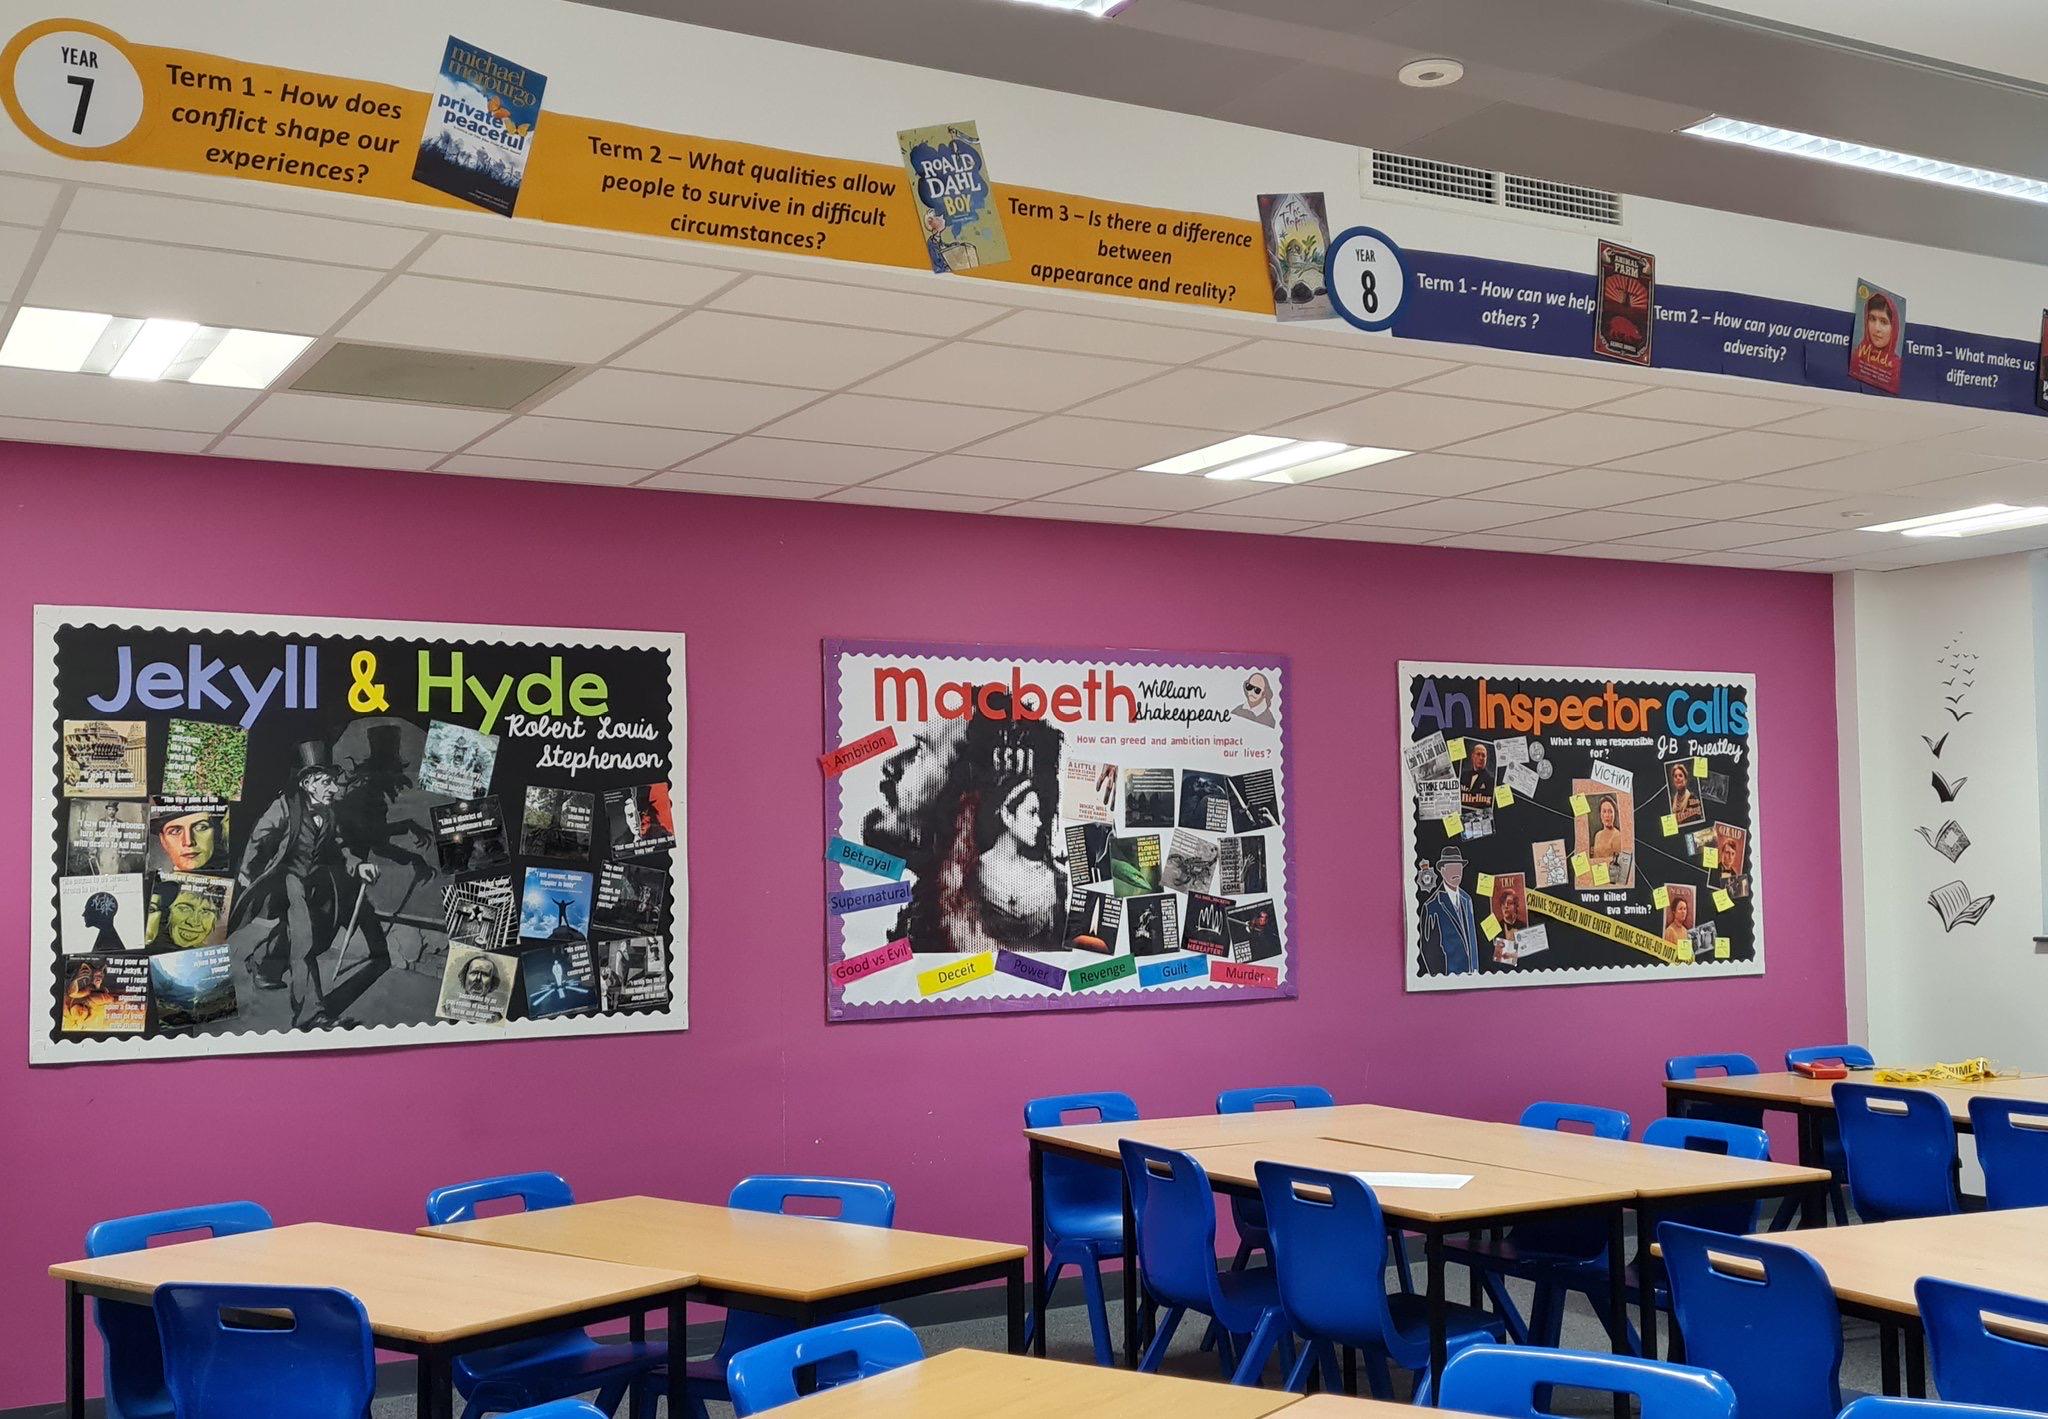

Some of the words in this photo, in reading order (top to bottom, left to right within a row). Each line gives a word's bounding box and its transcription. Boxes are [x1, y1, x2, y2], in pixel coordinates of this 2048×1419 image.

[61, 46, 98, 69] YEAR
[451, 47, 526, 87] michael
[66, 75, 95, 135] 7
[166, 63, 232, 94] Term
[242, 75, 255, 97] 1
[280, 83, 338, 110] How
[345, 93, 402, 120] does
[438, 94, 504, 128] private
[171, 104, 266, 135] conflict
[275, 117, 350, 152] shape
[357, 131, 400, 154] our
[444, 110, 525, 151] peaceful
[205, 145, 370, 185] experiences?
[588, 135, 643, 162] Term
[649, 146, 662, 164] 2
[688, 151, 745, 176] What
[750, 163, 837, 193] qualities
[843, 173, 896, 197] allow
[921, 153, 975, 179] ROALD
[926, 172, 981, 199] DAHL
[602, 171, 675, 201] people
[681, 182, 701, 201] to
[707, 188, 780, 214] survive
[787, 197, 805, 216] in
[811, 201, 887, 228] difficult
[943, 194, 971, 216] BOY
[669, 214, 827, 250] circumstances?
[1008, 197, 1054, 221] Term
[1059, 205, 1069, 222] 3
[1088, 210, 1101, 228] Is
[1107, 213, 1151, 236] there
[1156, 221, 1167, 236] a
[1172, 220, 1253, 249] difference
[1097, 239, 1172, 266] between
[1355, 248, 1376, 263] YEAR
[1030, 262, 1133, 291] appearance
[1138, 275, 1170, 295] and
[1174, 278, 1237, 304] reality?
[1614, 262, 1639, 279] FARM
[1361, 270, 1378, 314] 8
[1416, 272, 1454, 293] Term
[1458, 279, 1467, 294] 1
[1480, 280, 1512, 298] How
[1517, 288, 1542, 304] can
[1546, 292, 1566, 306] we
[1568, 293, 1596, 315] help
[1482, 308, 1527, 329] others
[1531, 313, 1540, 330] ?
[1654, 305, 1687, 323] Term
[1691, 309, 1699, 325] 2
[1713, 311, 1741, 330] How
[1744, 320, 1767, 334] can
[1768, 322, 1791, 340] you
[1794, 326, 1850, 347] overcome
[1723, 339, 1787, 362] adversity?
[1906, 340, 1932, 358] Term
[1936, 344, 1943, 358] 3
[1954, 346, 1984, 366] What
[1986, 352, 2021, 371] makes
[2023, 359, 2036, 372] us
[1946, 366, 1999, 388] different?
[87, 644, 317, 729] Jekyll
[348, 650, 389, 712] &
[418, 650, 609, 735] Hyde
[1139, 680, 1206, 700] William
[1134, 701, 1233, 729] Shakespeare
[1412, 679, 1473, 728] An
[1479, 679, 1662, 735] Inspector
[1666, 687, 1749, 736] Calls
[505, 713, 586, 739] Robert
[598, 715, 660, 740] Louis
[834, 736, 887, 768] Ambition
[1077, 734, 1096, 746] How
[1100, 736, 1116, 746] can
[1119, 735, 1146, 749] greed
[1151, 735, 1167, 746] and
[1171, 735, 1209, 747] ambition
[1213, 735, 1244, 749] impact
[1223, 749, 1239, 759] our
[1243, 747, 1272, 760] lives?
[1550, 736, 1572, 747] What
[1576, 738, 1592, 747] are
[1595, 738, 1608, 747] we
[1609, 736, 1654, 748] responsible
[1589, 749, 1610, 760] for?
[1688, 738, 1743, 763] Priestley
[536, 744, 664, 777] Stephenson
[1074, 762, 1096, 771] LITTLE
[1418, 782, 1438, 791] STRIKE
[1439, 780, 1459, 791] CALLED
[842, 845, 891, 872] Betrayal
[830, 884, 910, 911] Supernatural
[1581, 893, 1599, 903] Who
[1604, 892, 1627, 902] killed
[1607, 906, 1620, 916] Eva
[1624, 904, 1653, 916] Smith?
[1527, 893, 1548, 912] CRIME
[1579, 911, 1592, 925] NOT
[1592, 917, 1612, 934] ENTER
[1614, 925, 1635, 942] CRIME
[1662, 944, 1676, 959] NOT
[836, 960, 870, 979] Good
[872, 955, 885, 967] vs
[887, 945, 908, 961] Evil
[938, 962, 976, 984] Deceit
[1014, 958, 1049, 980] Power
[1080, 961, 1126, 984] Revenge
[1163, 963, 1188, 977] Guilt
[1226, 966, 1265, 982] Murder
